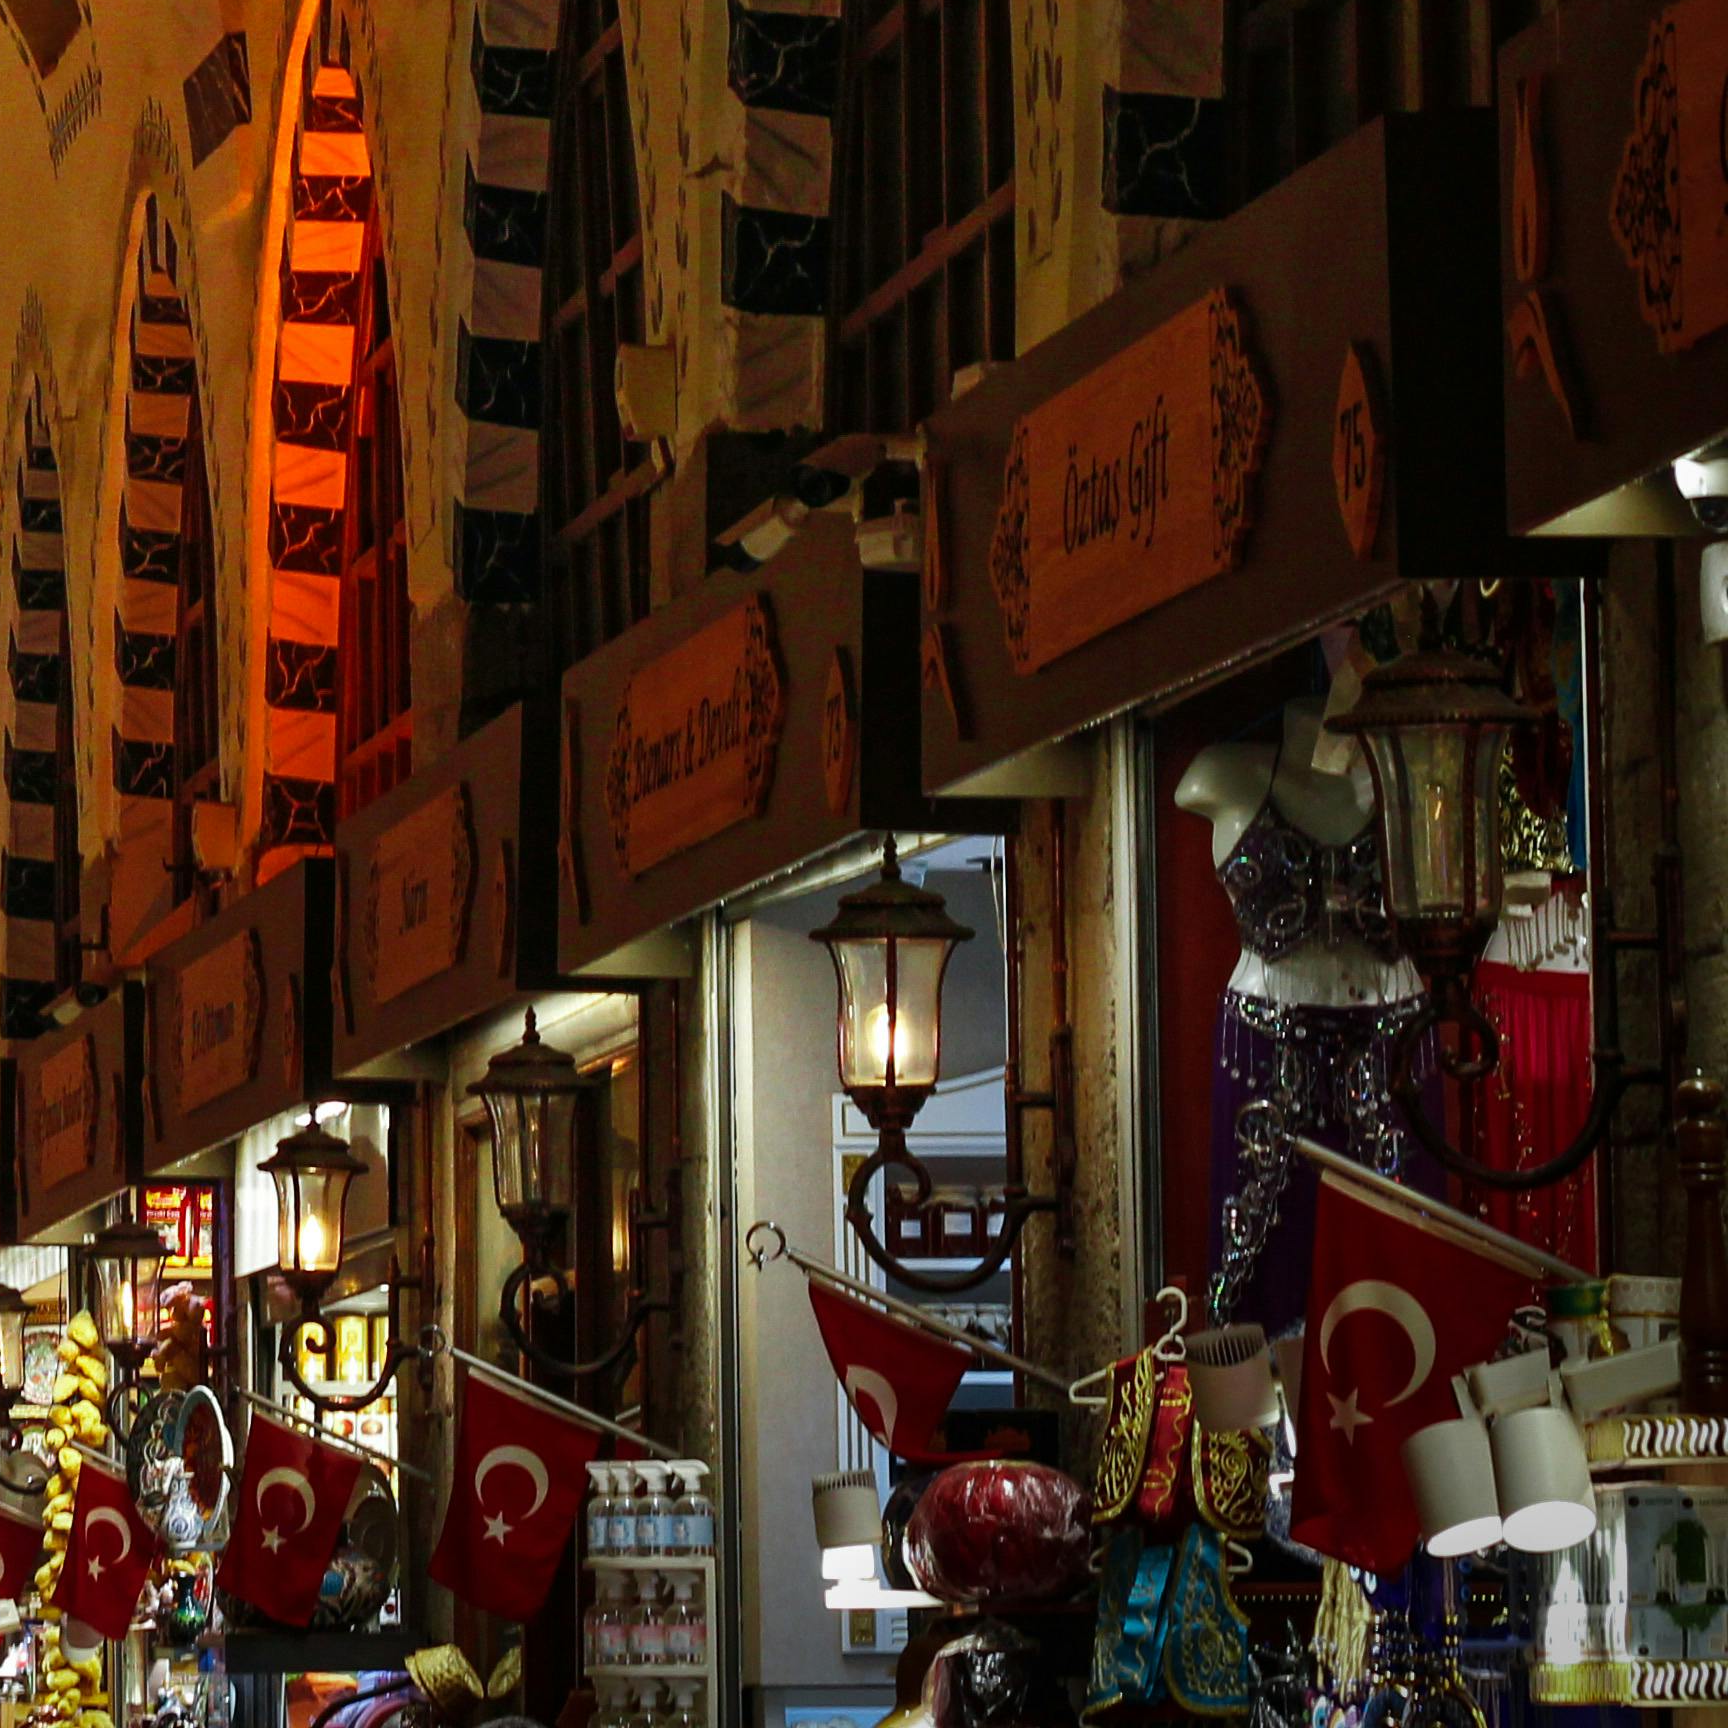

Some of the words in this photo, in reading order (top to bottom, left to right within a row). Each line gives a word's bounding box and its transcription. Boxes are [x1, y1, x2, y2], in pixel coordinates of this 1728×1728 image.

[1063, 443, 1121, 555] Öztaş
[1129, 394, 1169, 548] Gift
[1341, 403, 1366, 503] 75
[827, 692, 842, 769] 73
